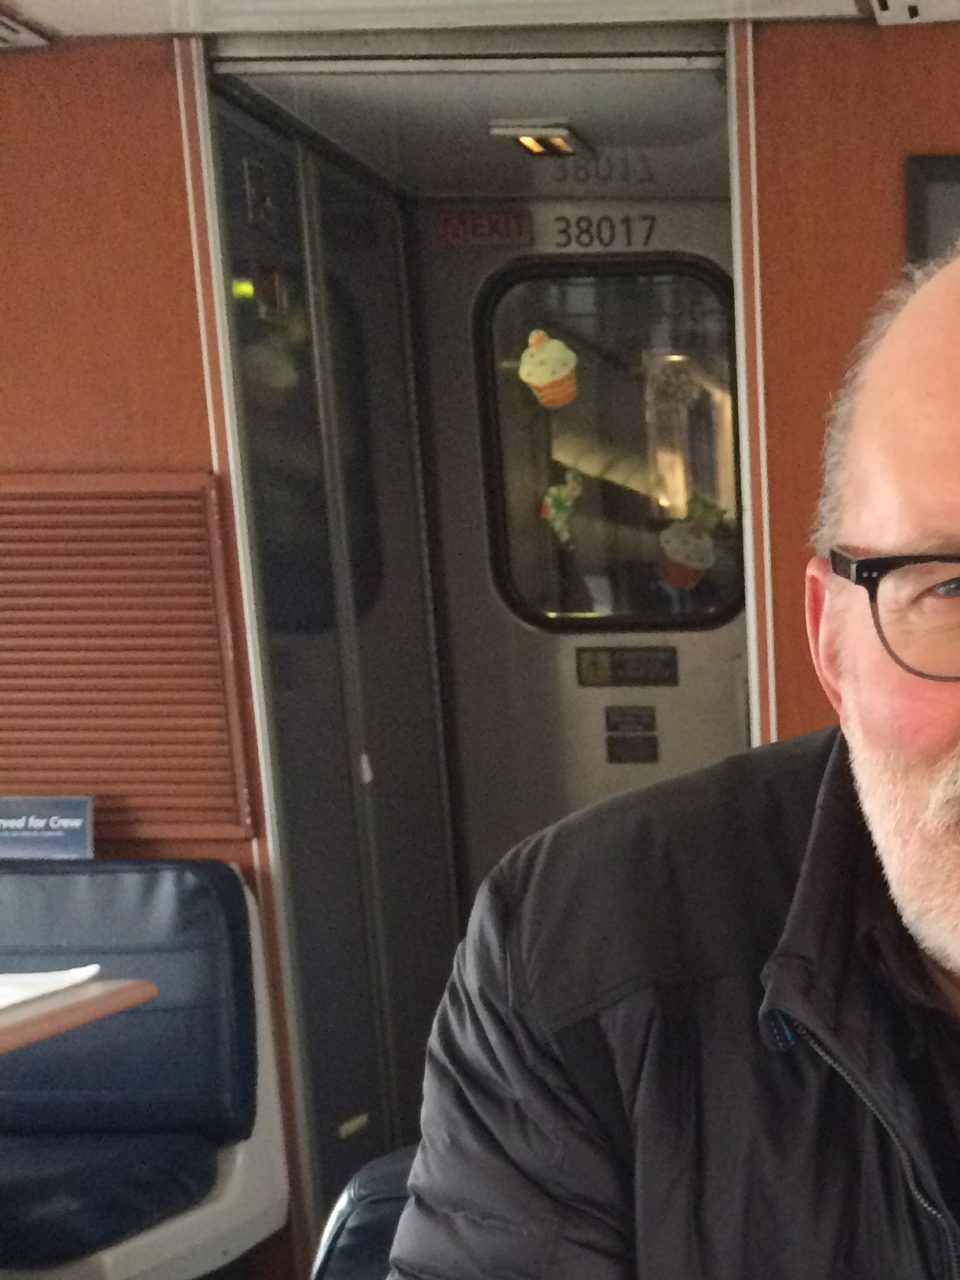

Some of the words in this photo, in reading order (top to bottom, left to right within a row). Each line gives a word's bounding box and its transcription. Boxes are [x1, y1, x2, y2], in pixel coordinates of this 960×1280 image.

[468, 212, 524, 236] EXIT
[554, 215, 657, 248] 38017
[27, 815, 48, 829] for
[49, 815, 84, 829] Crew
